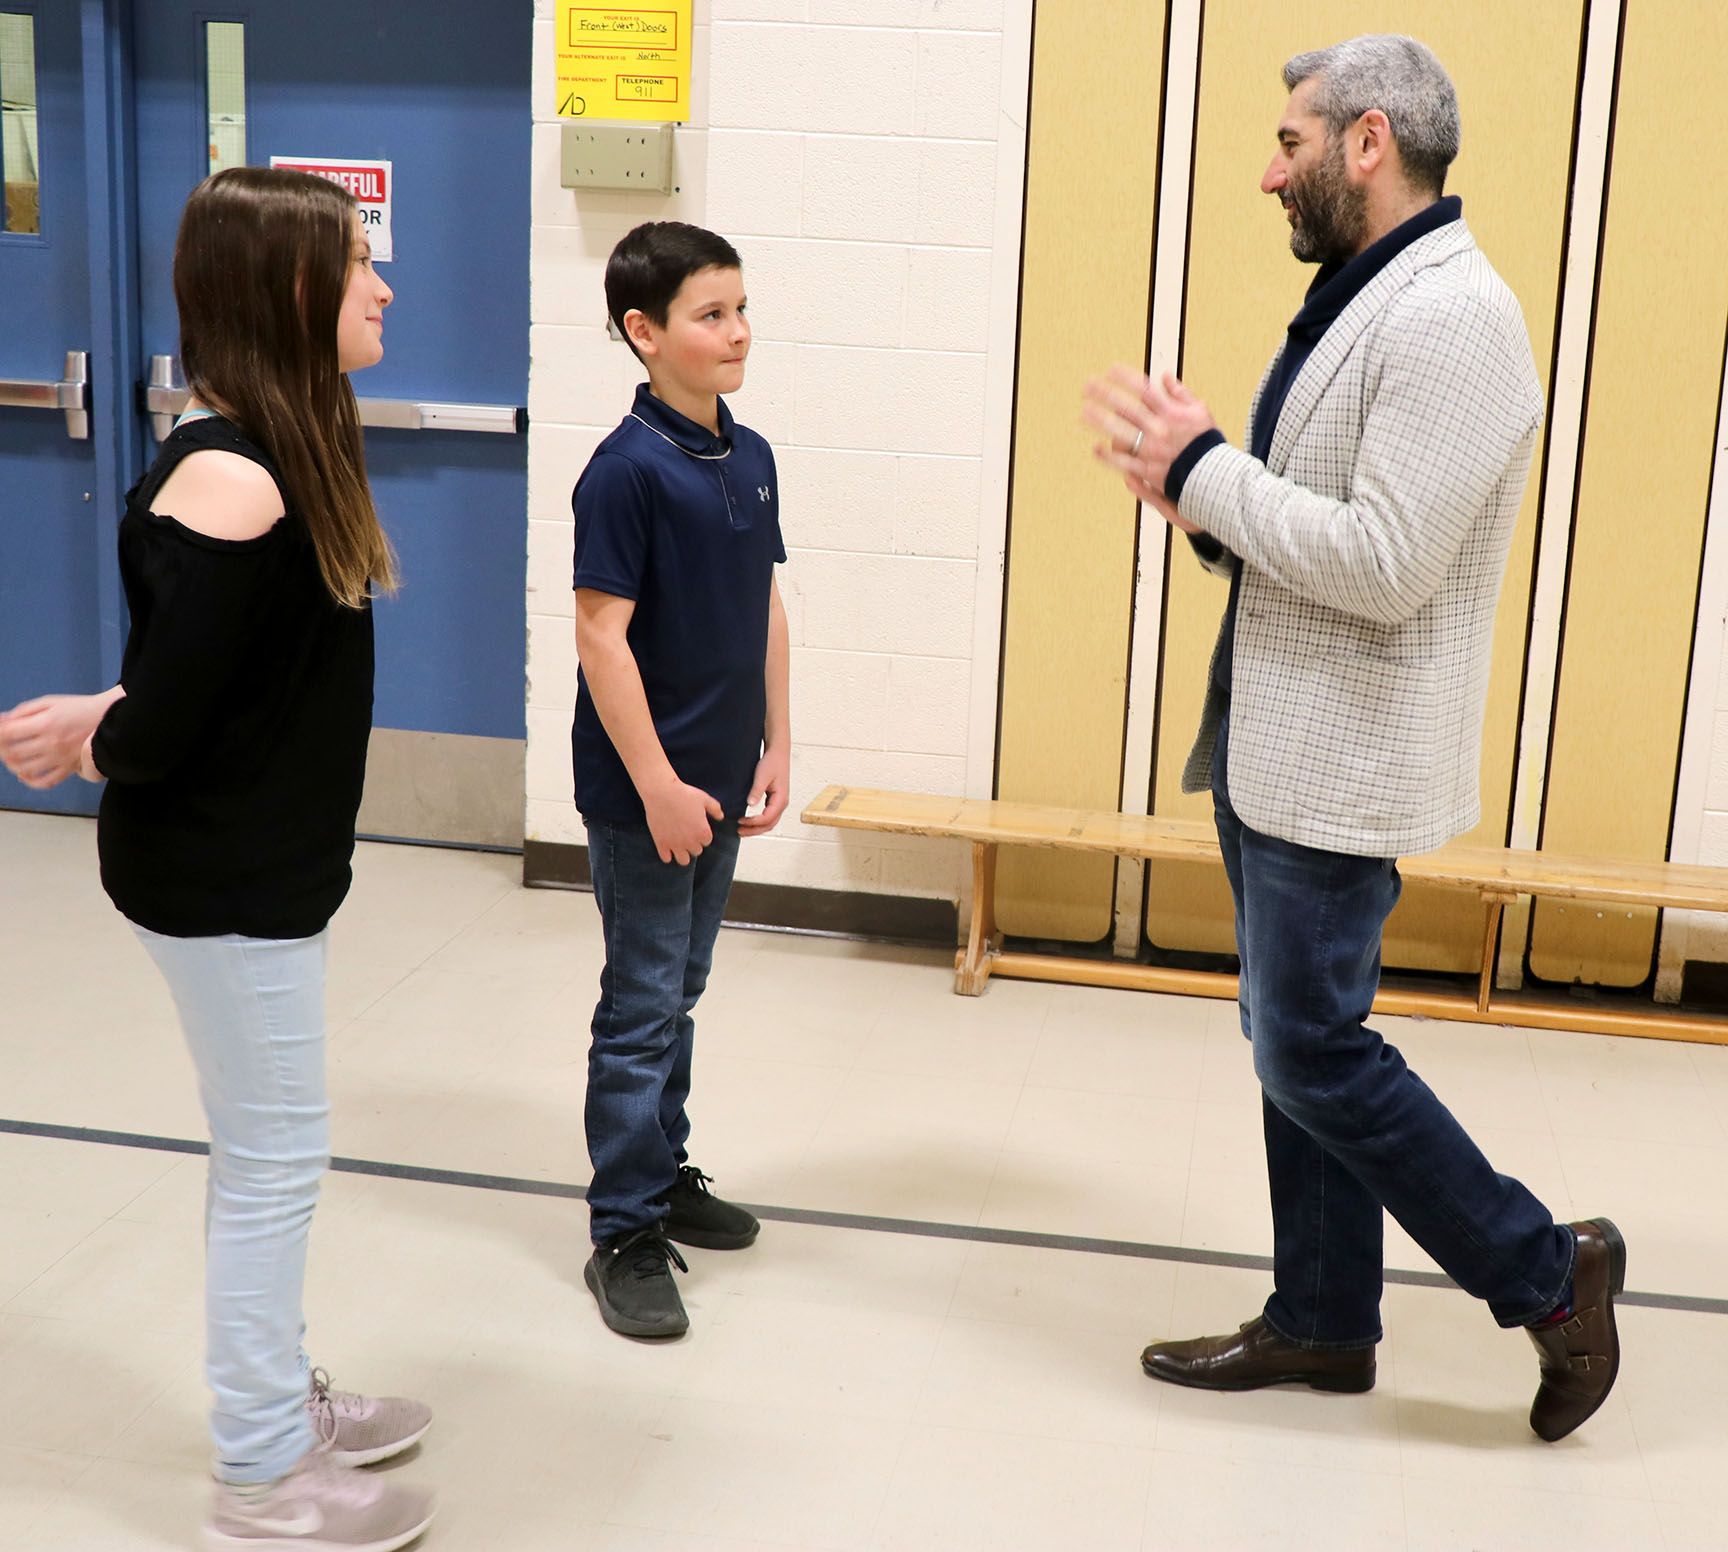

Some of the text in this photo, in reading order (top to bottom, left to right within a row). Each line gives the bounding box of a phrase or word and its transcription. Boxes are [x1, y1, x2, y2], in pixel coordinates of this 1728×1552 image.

[580, 19, 608, 31] Front
[634, 85, 653, 98] 911
[306, 171, 382, 198] EFUL
